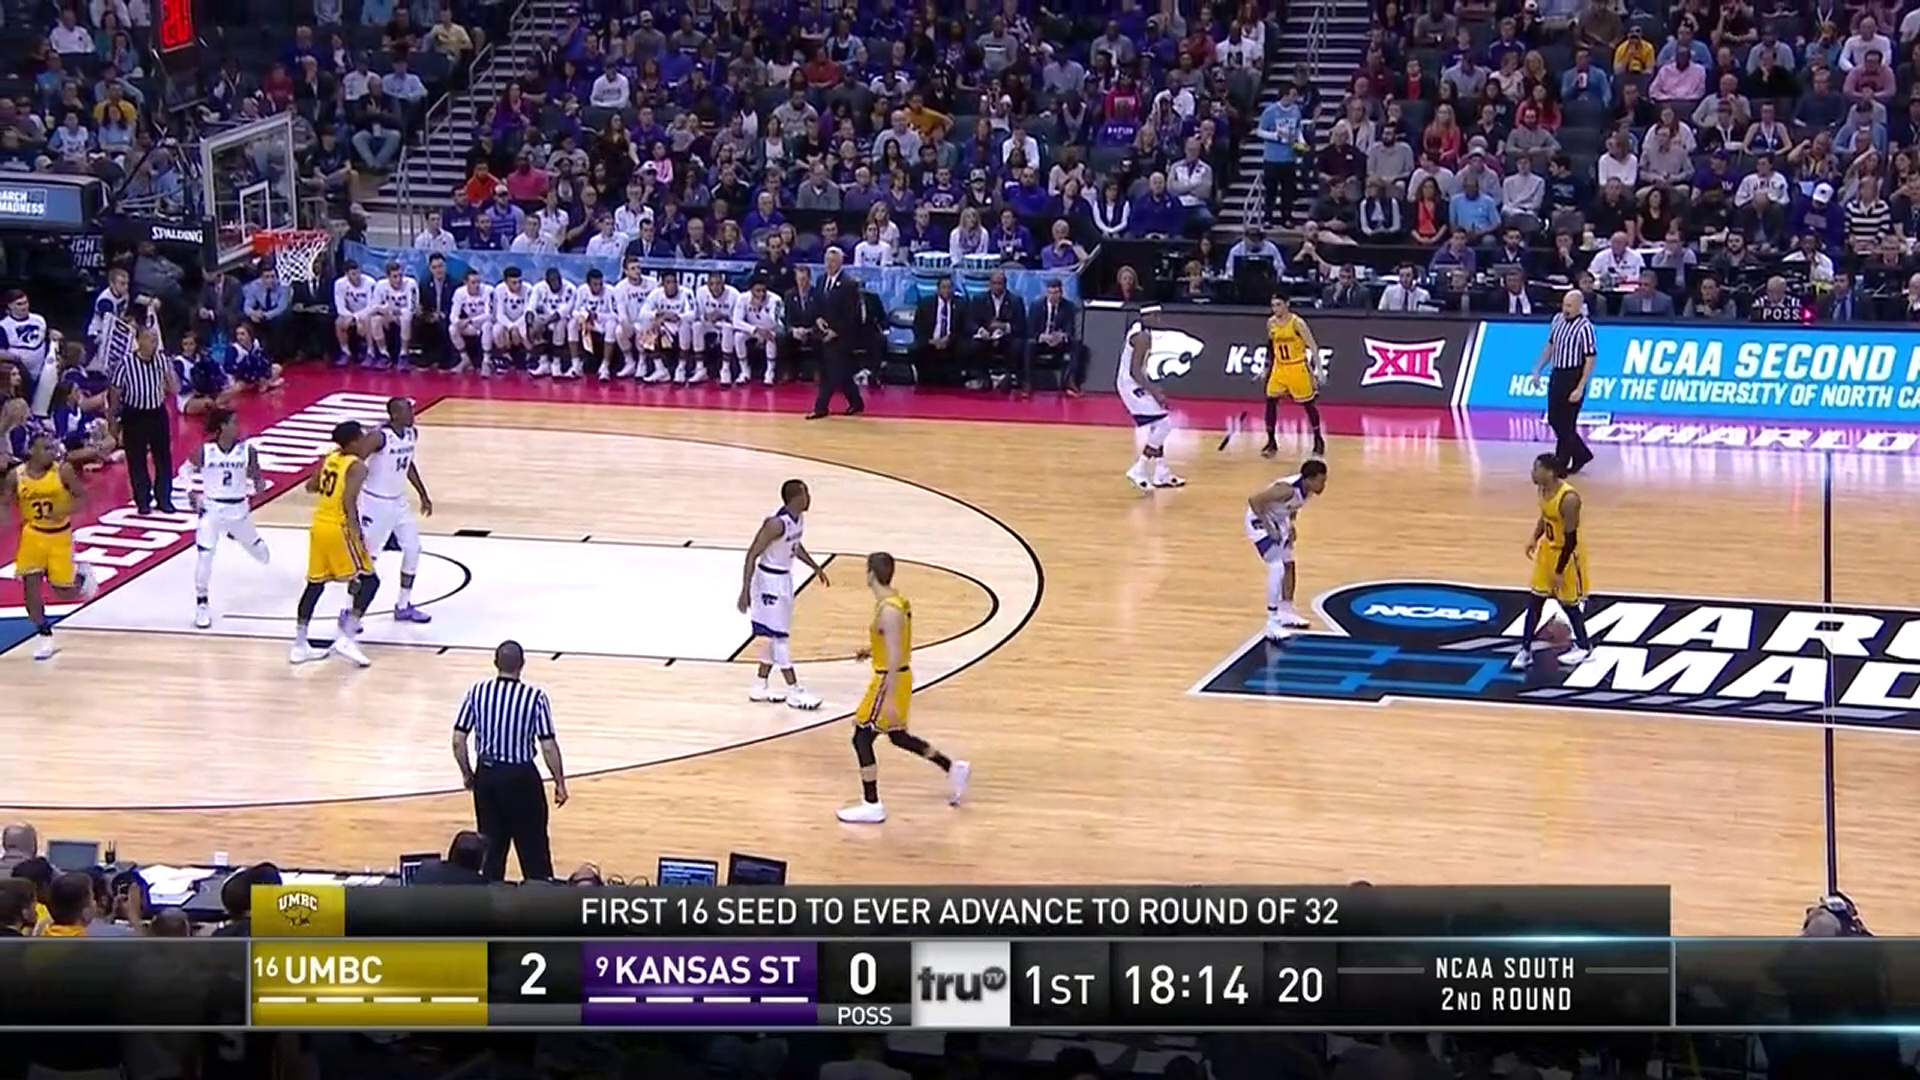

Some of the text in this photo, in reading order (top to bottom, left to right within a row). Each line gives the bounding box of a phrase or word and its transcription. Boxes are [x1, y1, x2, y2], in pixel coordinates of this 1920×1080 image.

[0, 190, 28, 202] ARCH
[151, 226, 203, 244] SPALDING
[1762, 307, 1801, 320] POSS
[1623, 339, 1723, 378] NCAA
[1734, 340, 1897, 381] SECOND
[1588, 377, 1617, 399] BY
[1620, 378, 1657, 401] THE
[1660, 379, 1789, 406] UNIVERSITY
[1790, 382, 1818, 406] OF
[1821, 383, 1894, 408] NORTH
[222, 470, 233, 486] 2
[1363, 603, 1491, 622] NCAA
